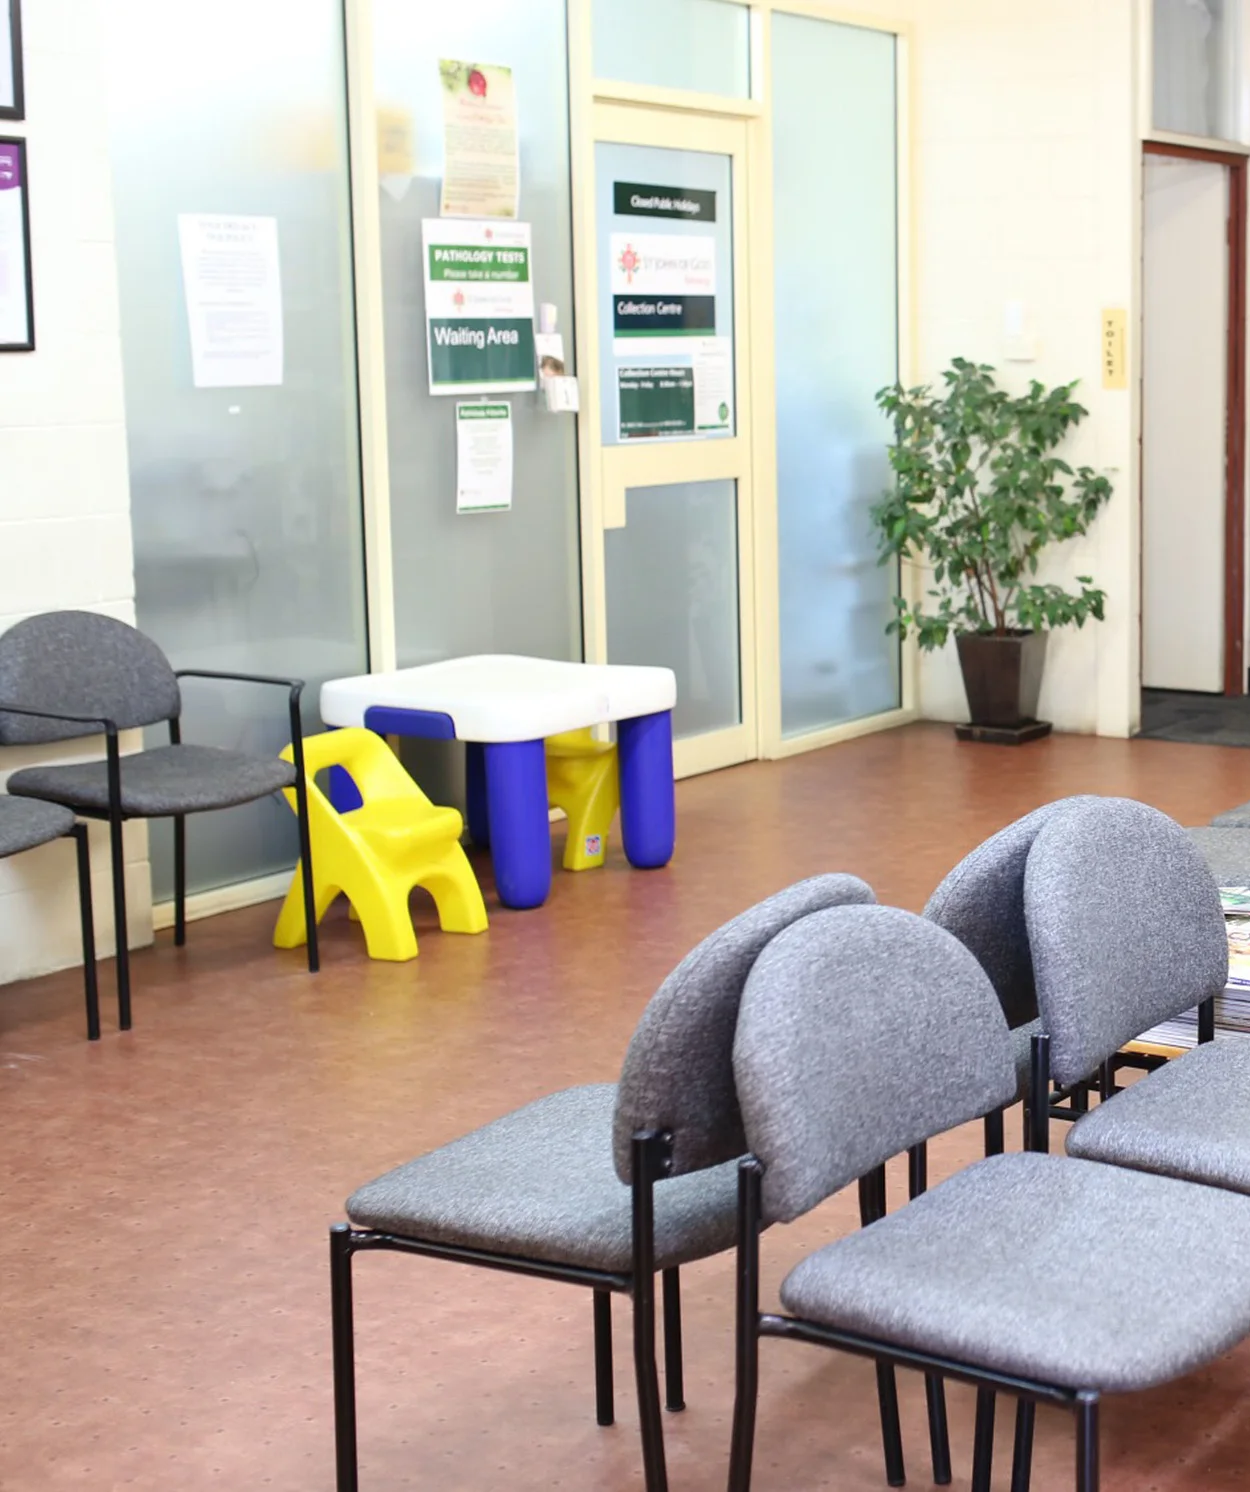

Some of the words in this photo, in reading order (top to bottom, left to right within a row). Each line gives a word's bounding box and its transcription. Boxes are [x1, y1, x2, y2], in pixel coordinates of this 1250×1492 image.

[434, 250, 494, 263] PATHOLOGY
[496, 251, 525, 264] TESTS
[444, 268, 467, 279] Please
[468, 269, 484, 279] take
[491, 269, 520, 280] number
[617, 301, 656, 315] Collection
[656, 301, 682, 315] Centre
[434, 327, 485, 349] Waiting
[487, 327, 519, 345] Area
